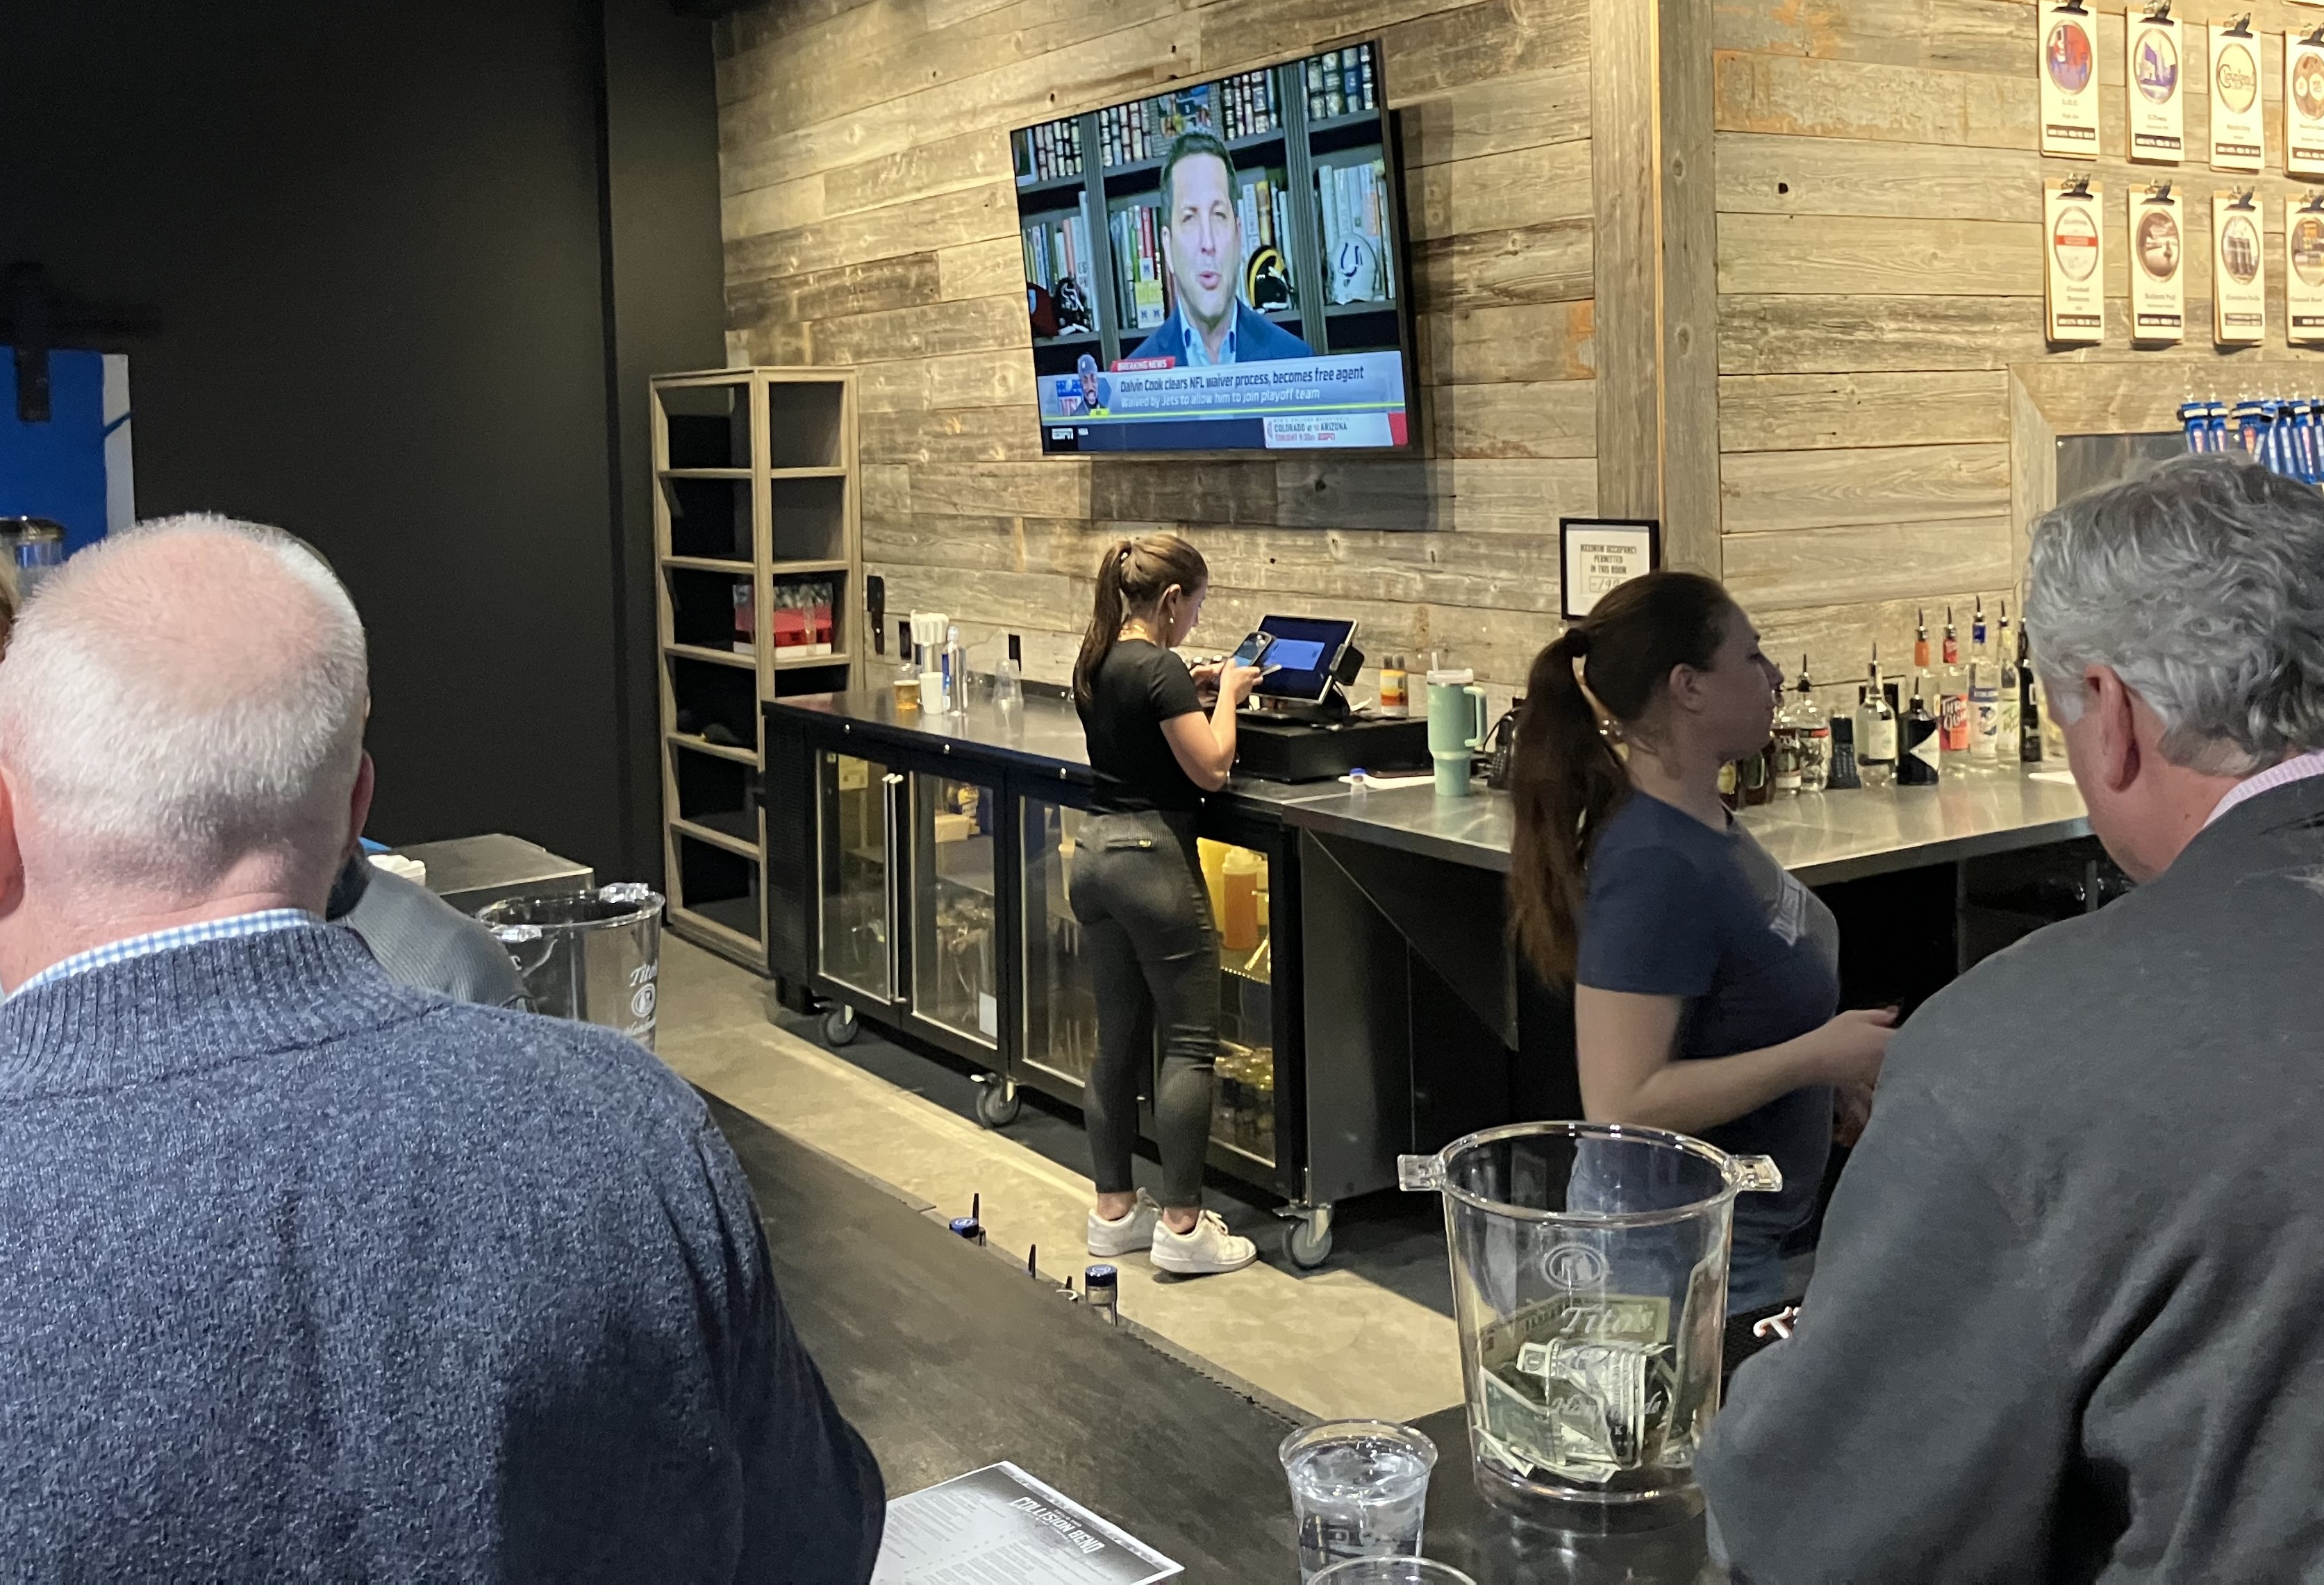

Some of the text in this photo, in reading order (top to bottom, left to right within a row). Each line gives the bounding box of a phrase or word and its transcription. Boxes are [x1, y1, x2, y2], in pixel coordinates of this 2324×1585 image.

[1118, 359, 1167, 372] BREAKING NEWS
[1120, 365, 1364, 392] Dalvin Cook clears NFL waiver process, becomes free agent
[1121, 387, 1320, 408] Waived by Jets to allow him to join playoff team
[1275, 424, 1306, 432] COLORADO
[1321, 422, 1348, 431] ARIZONA
[1052, 428, 1074, 440] ESPN
[1606, 545, 1636, 554] OCCUPANCY
[1594, 555, 1623, 563] PERMITTED
[1008, 1496, 1076, 1532] COLLISION
[1068, 1529, 1105, 1554] BEND
